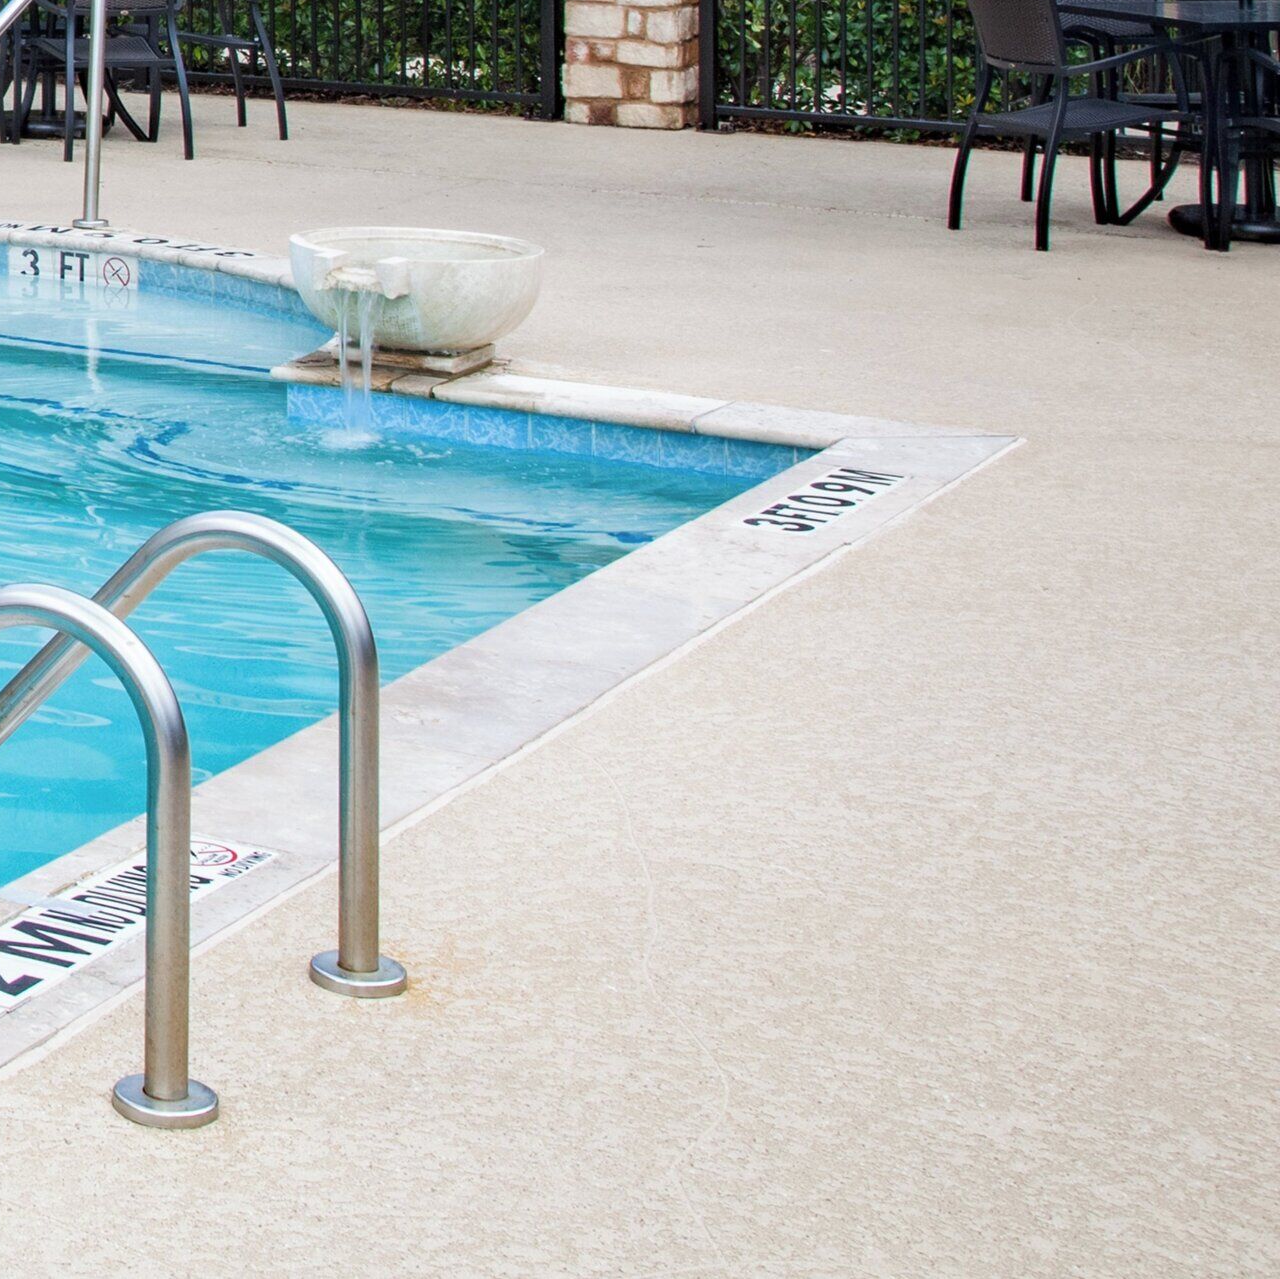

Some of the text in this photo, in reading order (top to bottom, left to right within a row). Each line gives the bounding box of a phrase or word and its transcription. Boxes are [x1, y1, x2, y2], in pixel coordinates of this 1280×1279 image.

[21, 248, 90, 281] 3 FT
[743, 518, 815, 532] 3
[828, 468, 904, 486] M
